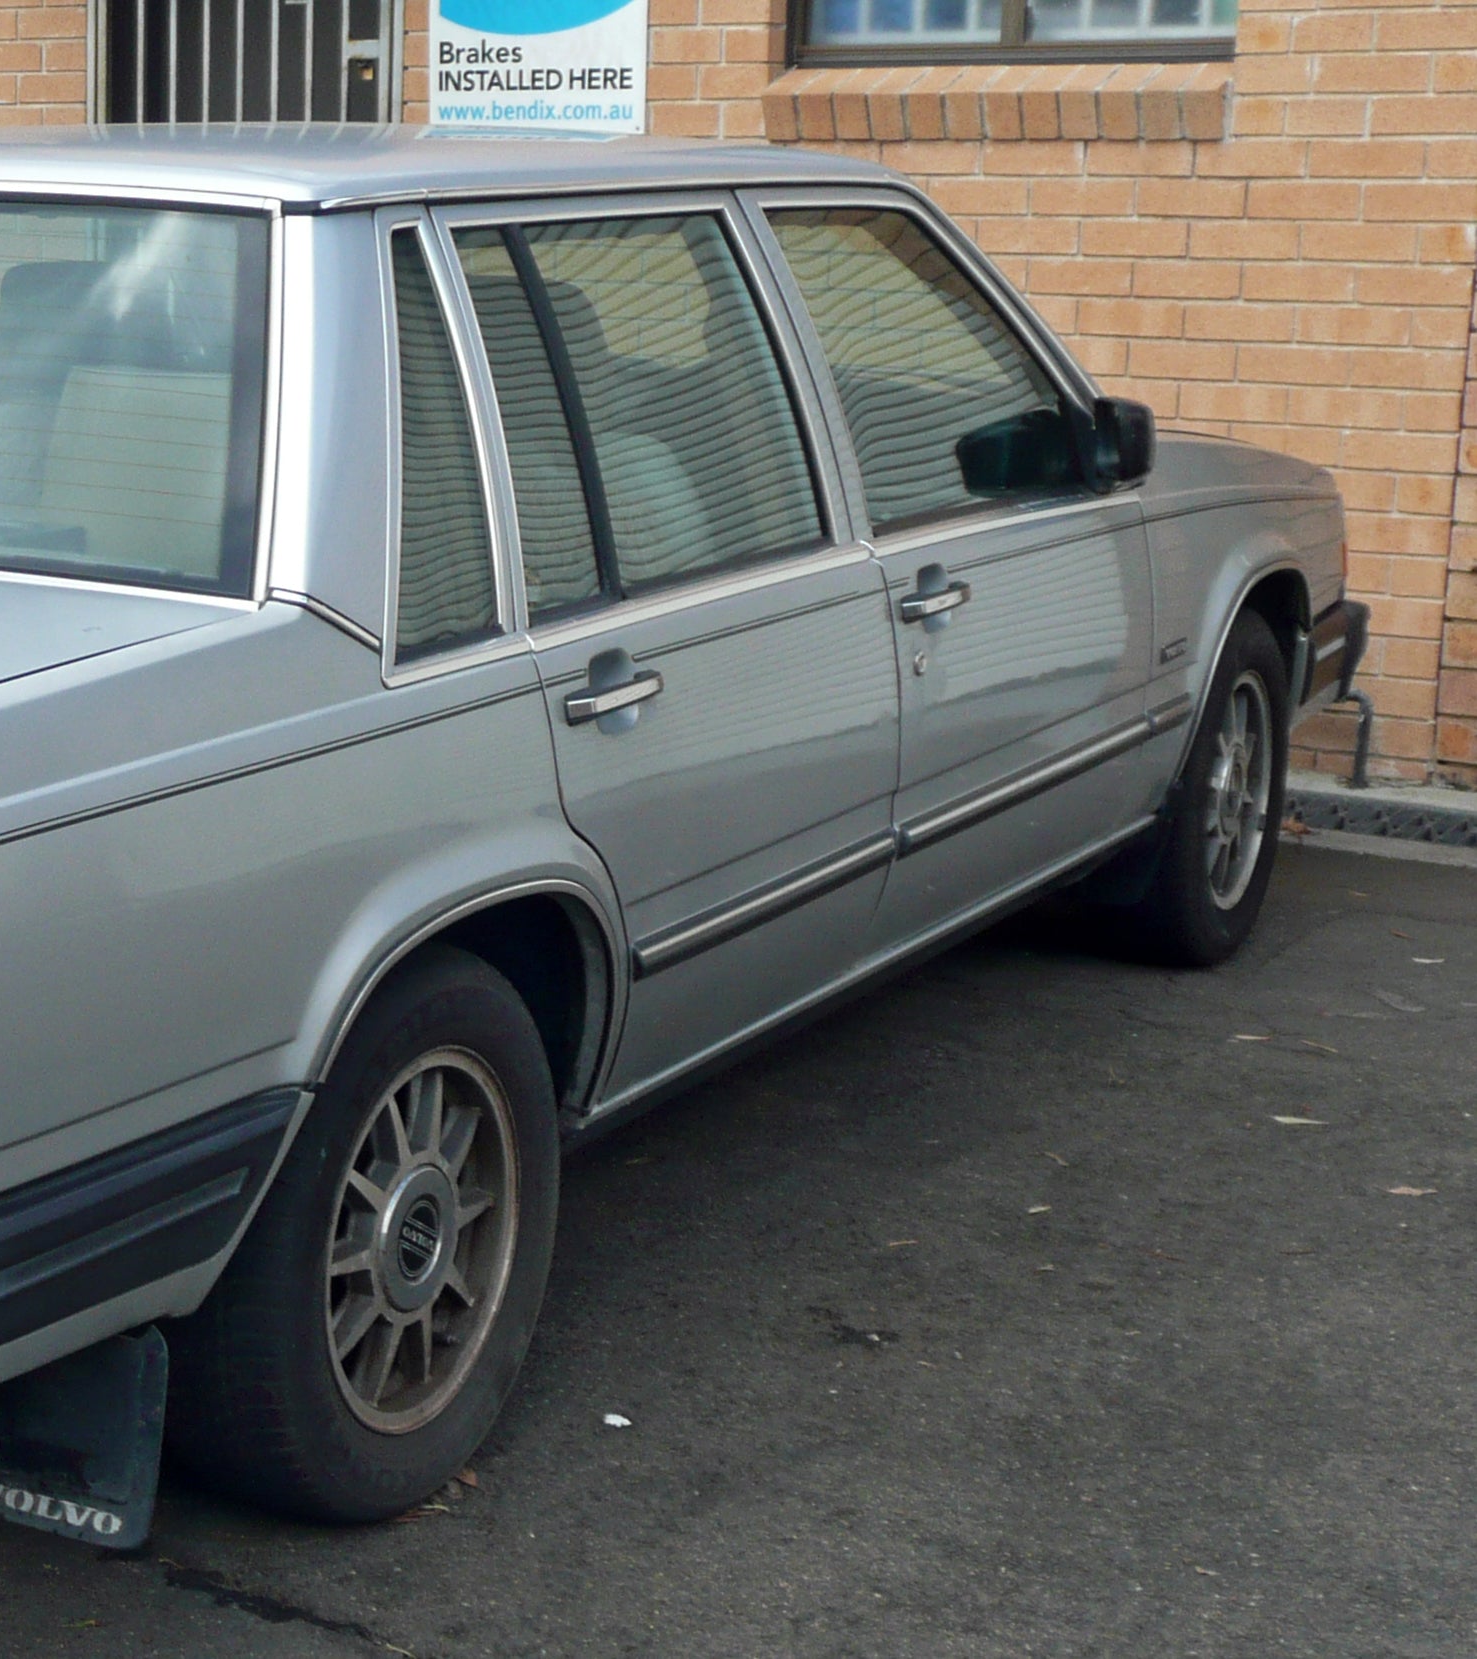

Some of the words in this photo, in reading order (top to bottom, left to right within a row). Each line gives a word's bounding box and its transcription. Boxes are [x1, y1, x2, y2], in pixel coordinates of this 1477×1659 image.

[438, 39, 523, 64] Brakes
[438, 69, 563, 92] INSTALLED
[569, 68, 633, 90] HERE
[438, 100, 633, 121] www.bendix.com.au
